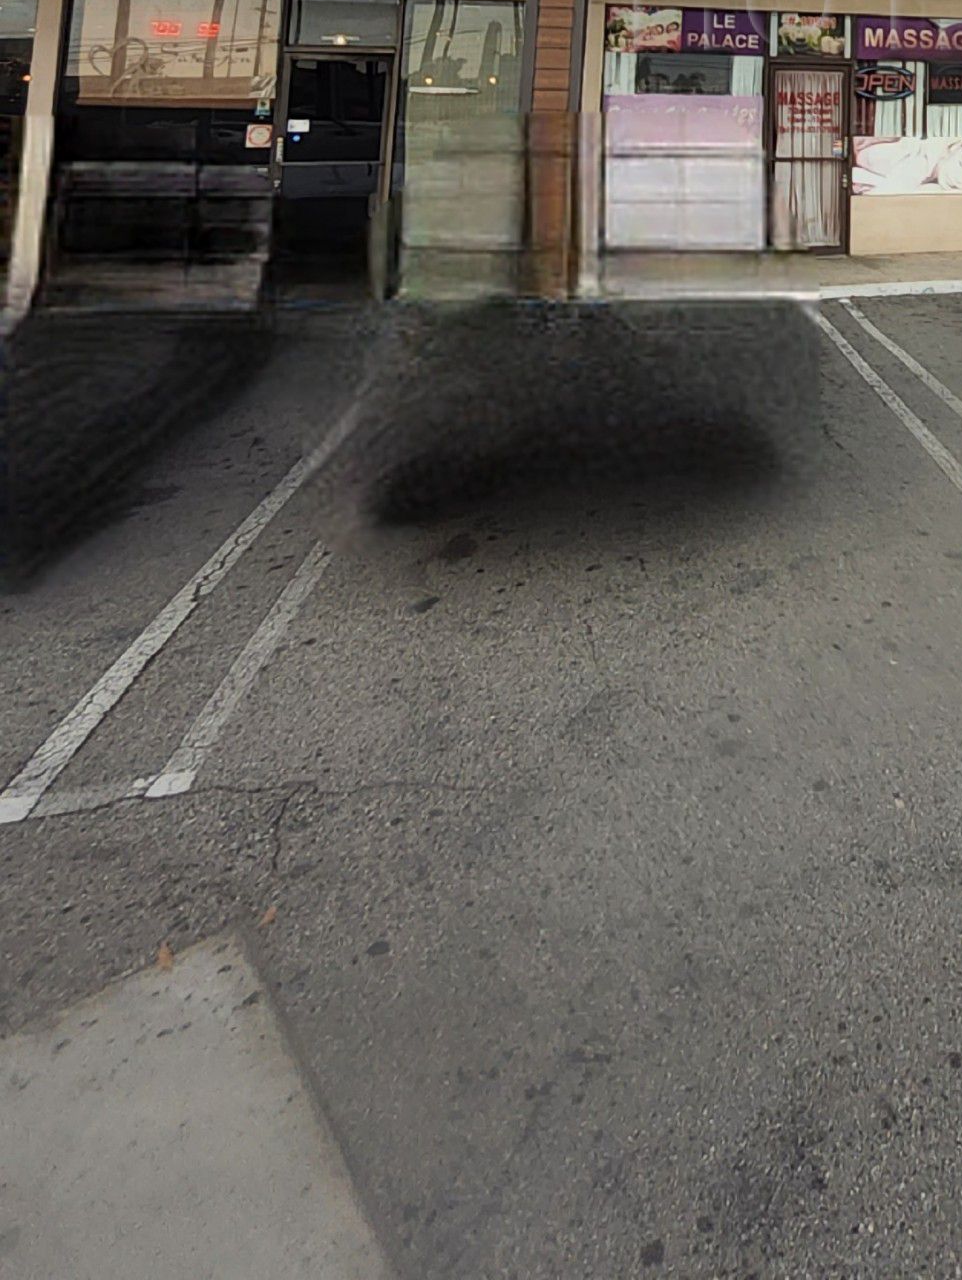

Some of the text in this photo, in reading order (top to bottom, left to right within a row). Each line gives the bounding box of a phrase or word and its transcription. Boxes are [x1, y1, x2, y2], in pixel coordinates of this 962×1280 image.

[713, 13, 736, 29] LE
[687, 32, 760, 50] PALACE
[777, 91, 840, 106] MASSAGE
